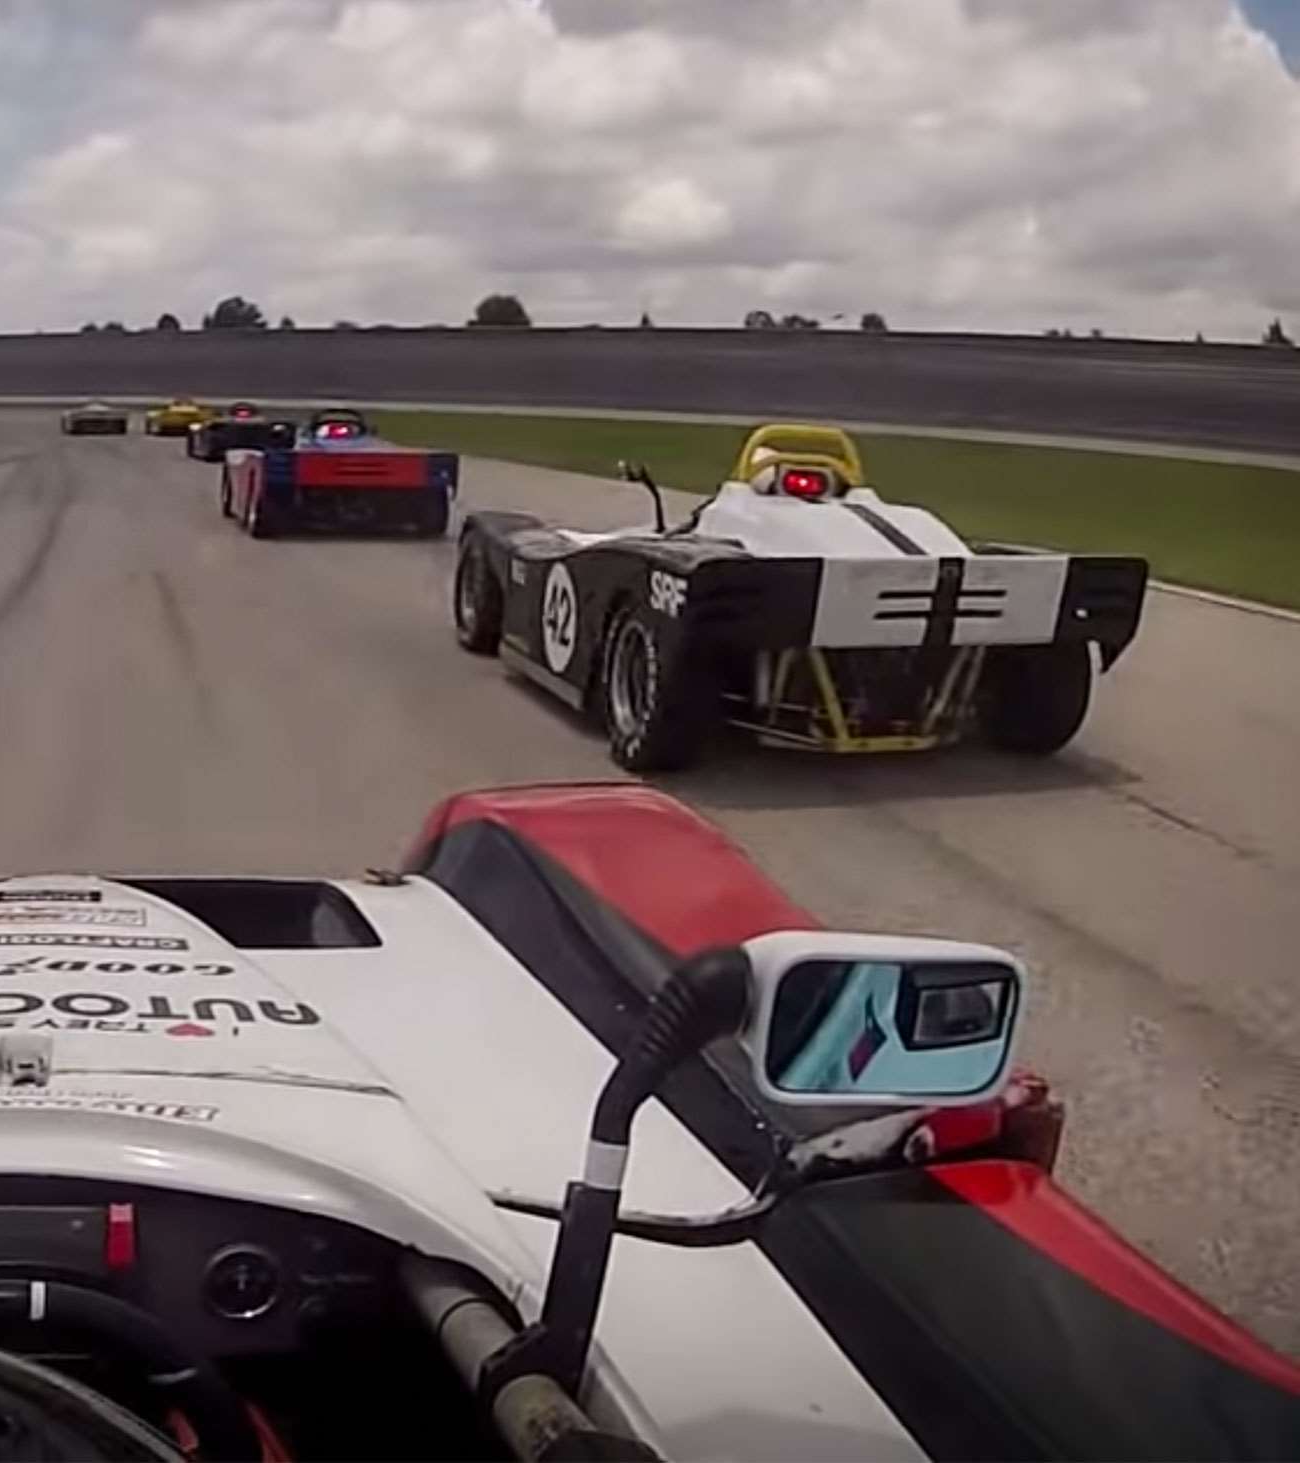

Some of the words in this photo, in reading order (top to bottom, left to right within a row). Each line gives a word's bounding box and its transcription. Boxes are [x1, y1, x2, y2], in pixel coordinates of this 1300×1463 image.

[545, 583, 571, 647] 42
[650, 570, 688, 618] SRF
[26, 1019, 152, 1035] TREY
